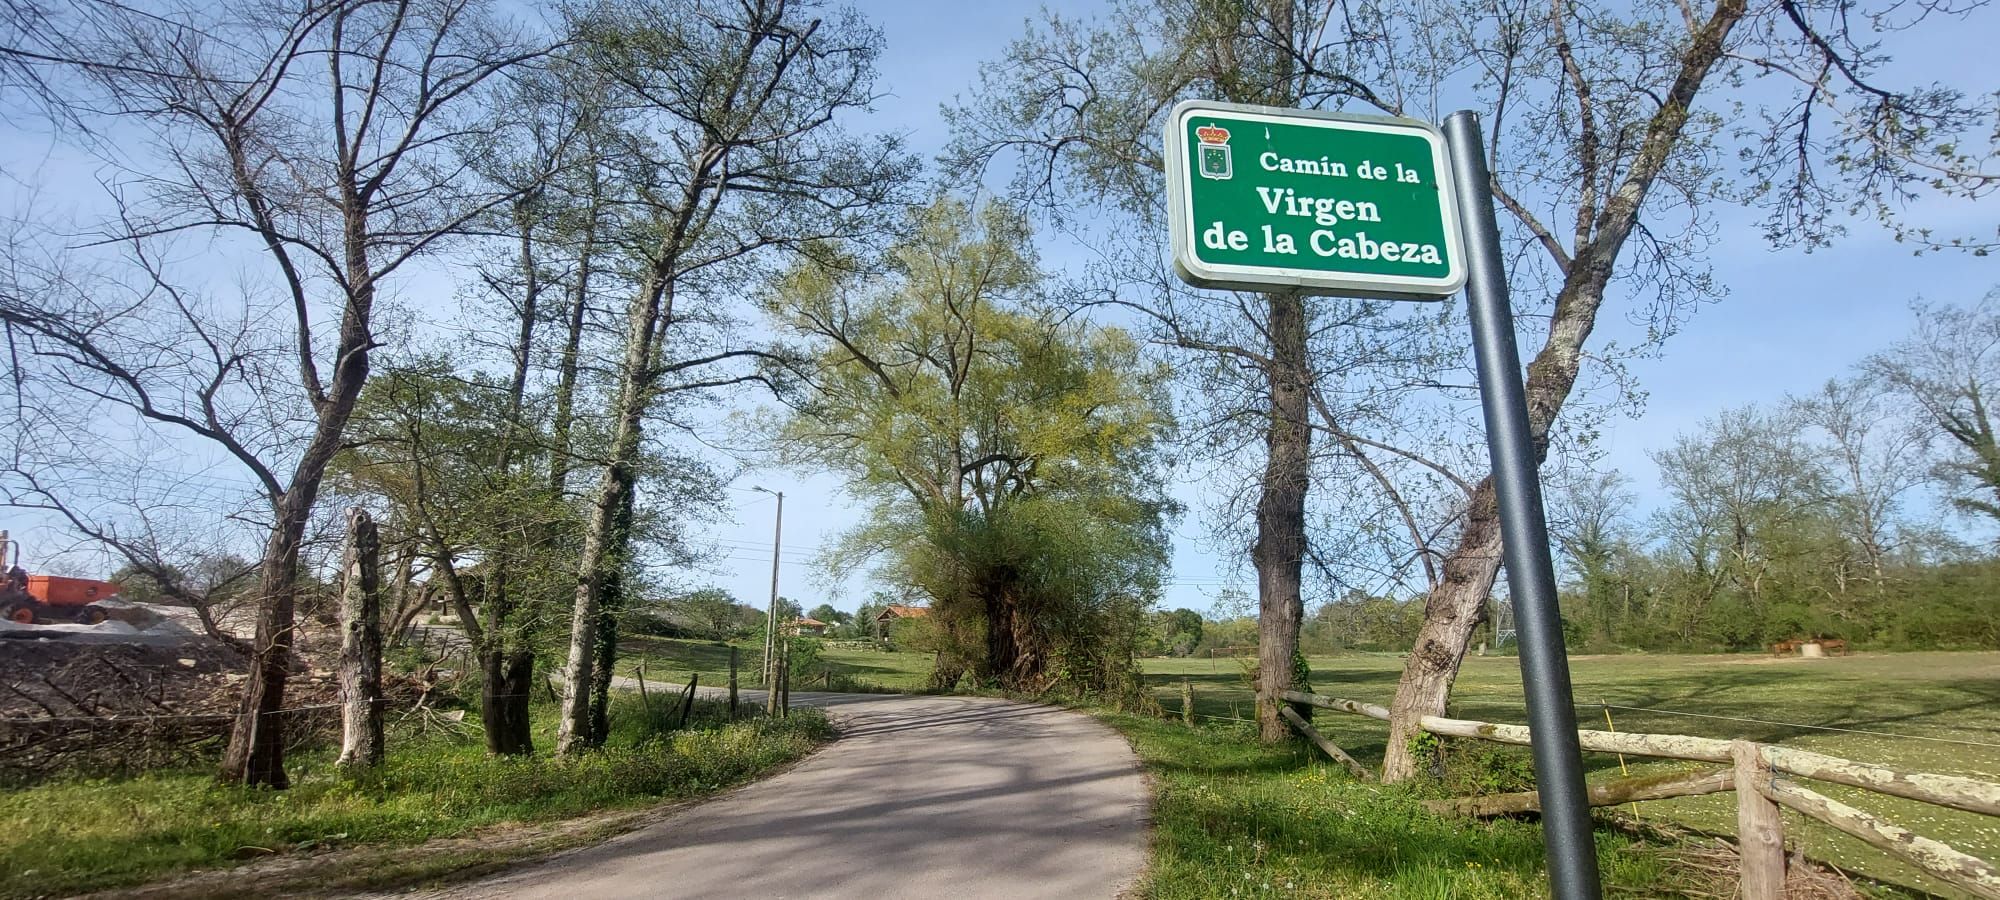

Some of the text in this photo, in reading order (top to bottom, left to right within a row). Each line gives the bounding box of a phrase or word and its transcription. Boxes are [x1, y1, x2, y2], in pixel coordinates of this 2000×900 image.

[1260, 152, 1420, 184] Camín de la
[1256, 187, 1381, 226] Virgen
[1203, 221, 1442, 265] de la Cabeza
